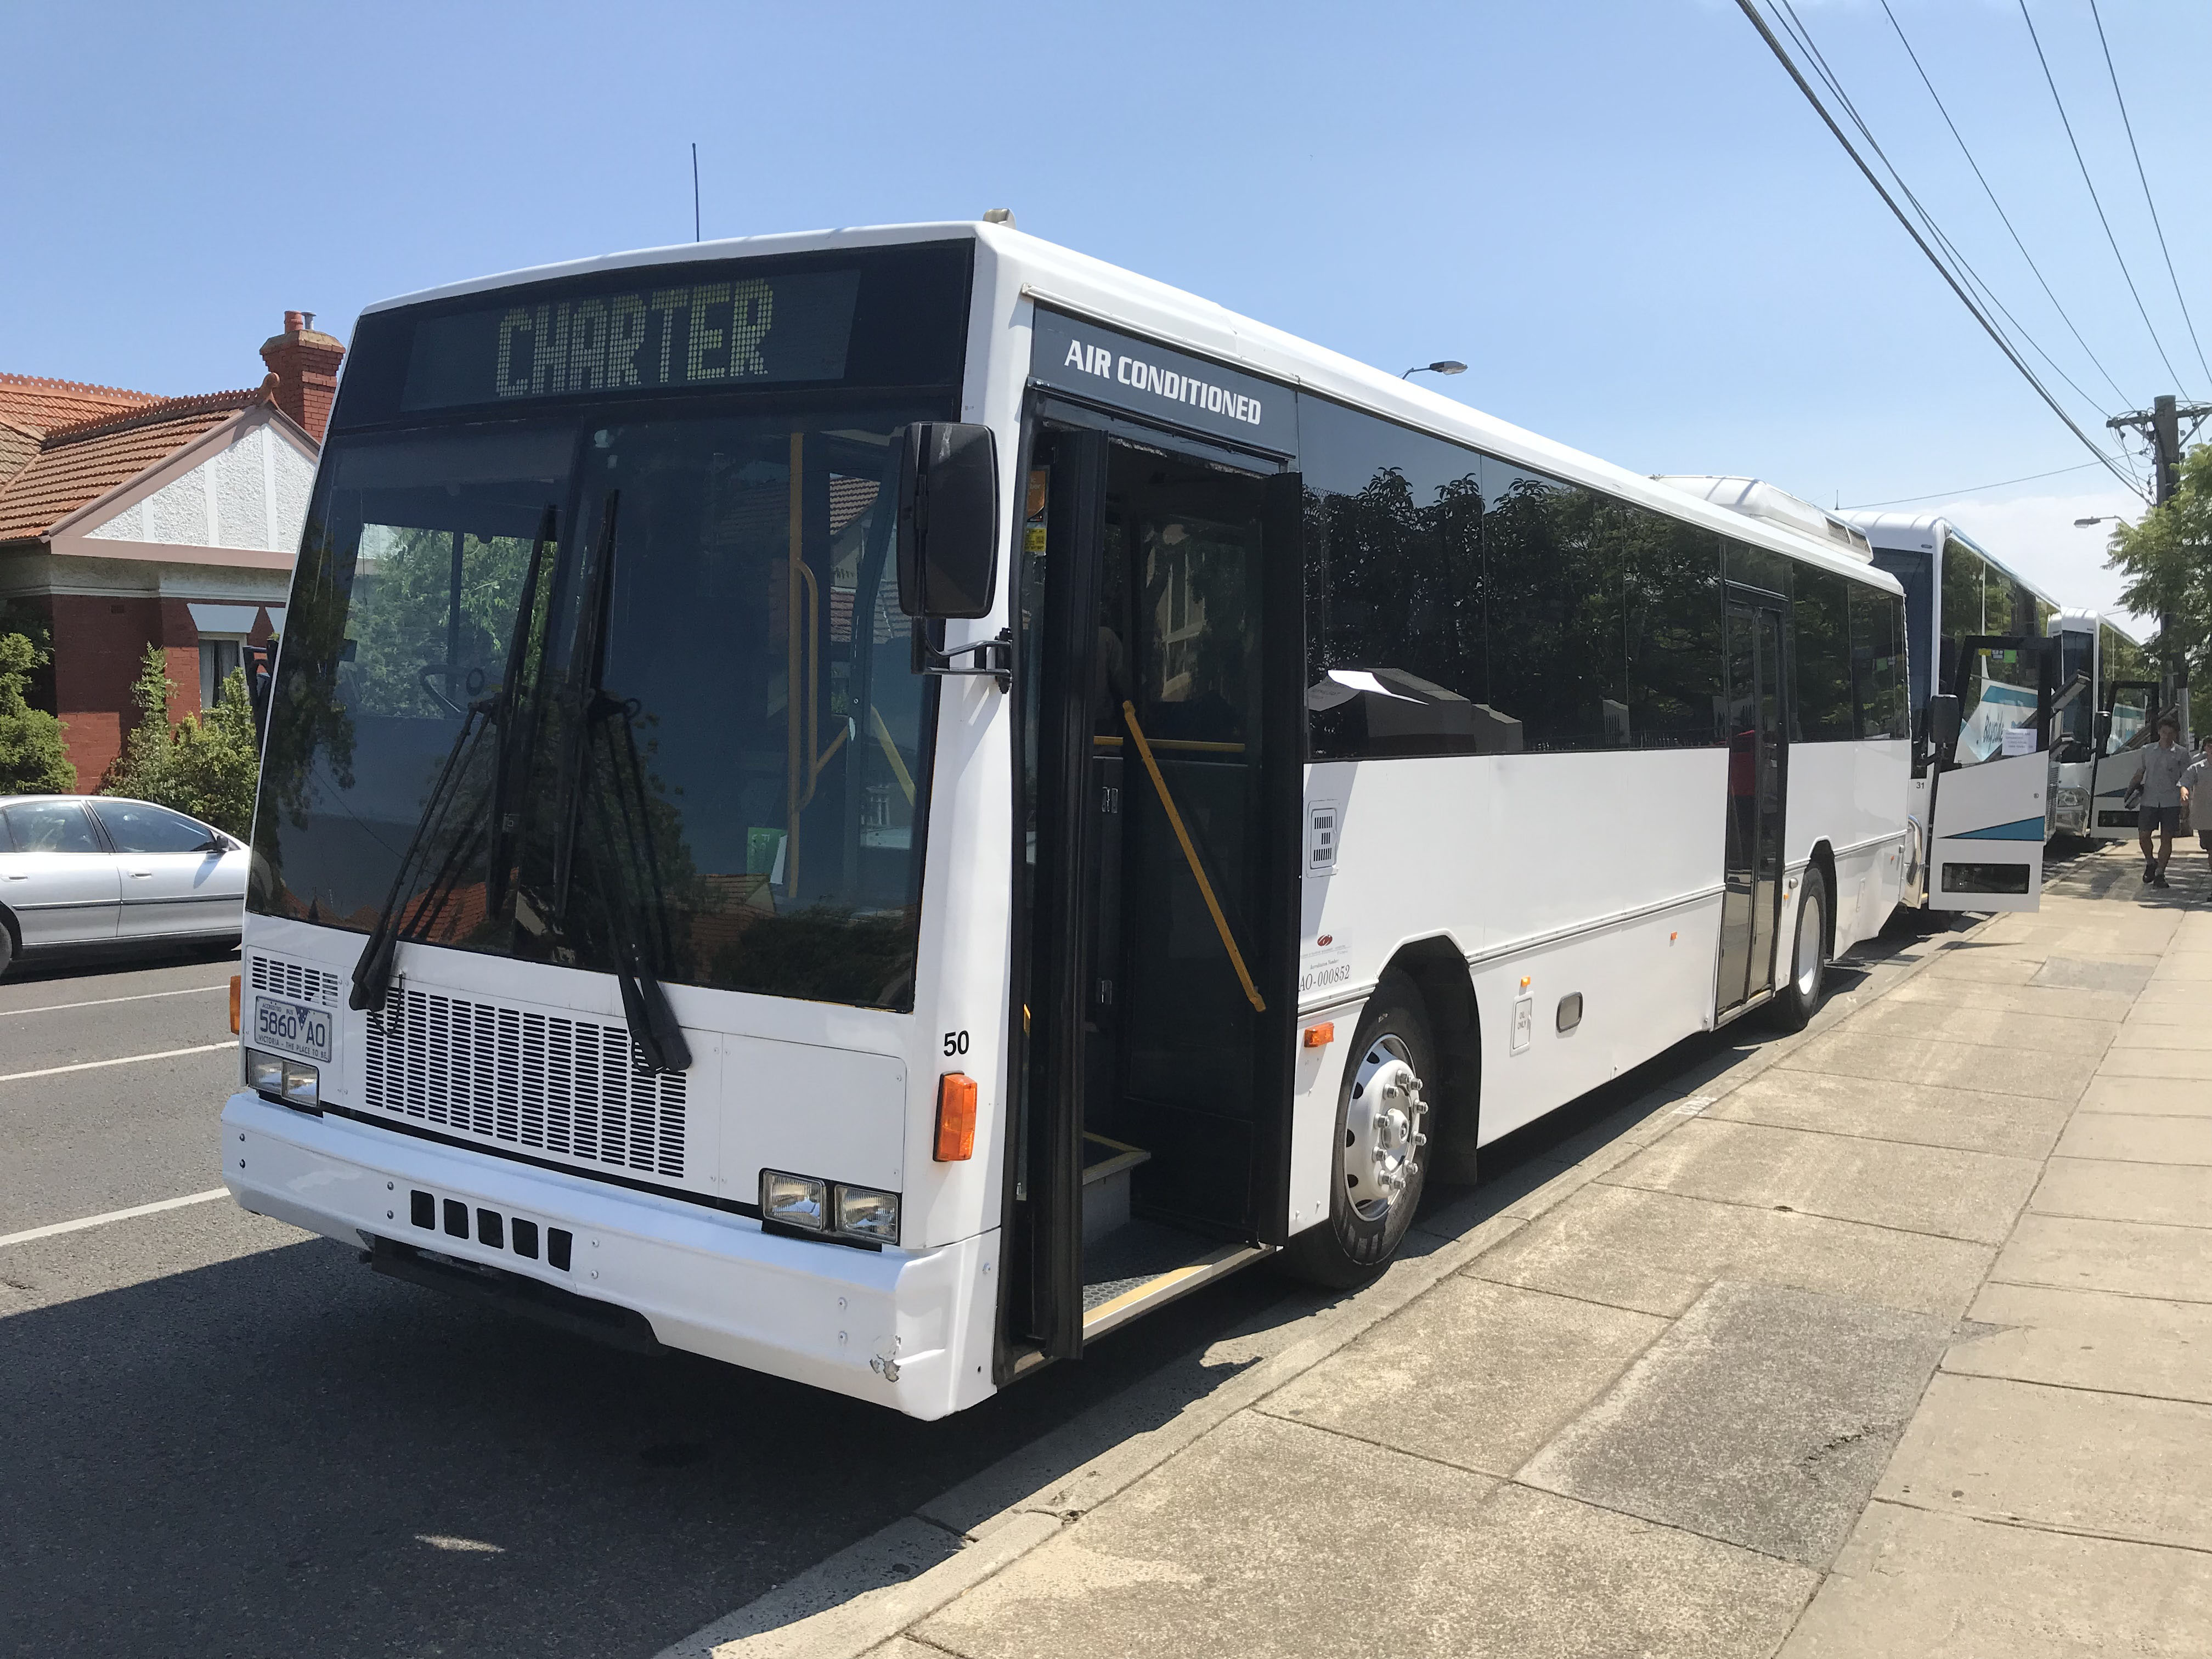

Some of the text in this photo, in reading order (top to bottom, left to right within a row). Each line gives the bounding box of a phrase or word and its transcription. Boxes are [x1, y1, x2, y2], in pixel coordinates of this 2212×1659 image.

[496, 278, 773, 397] CHARTER
[1064, 339, 1261, 425] AIR CONDITIONED
[1298, 964, 1350, 992] AO-000852
[260, 1008, 325, 1047] 5860 AO
[1517, 1019, 1527, 1030] ONLY
[258, 1034, 279, 1046] VICTORIA
[286, 1041, 294, 1051] THE
[296, 1044, 310, 1054] PLACE
[312, 1048, 318, 1057] TO
[944, 1030, 969, 1057] 50
